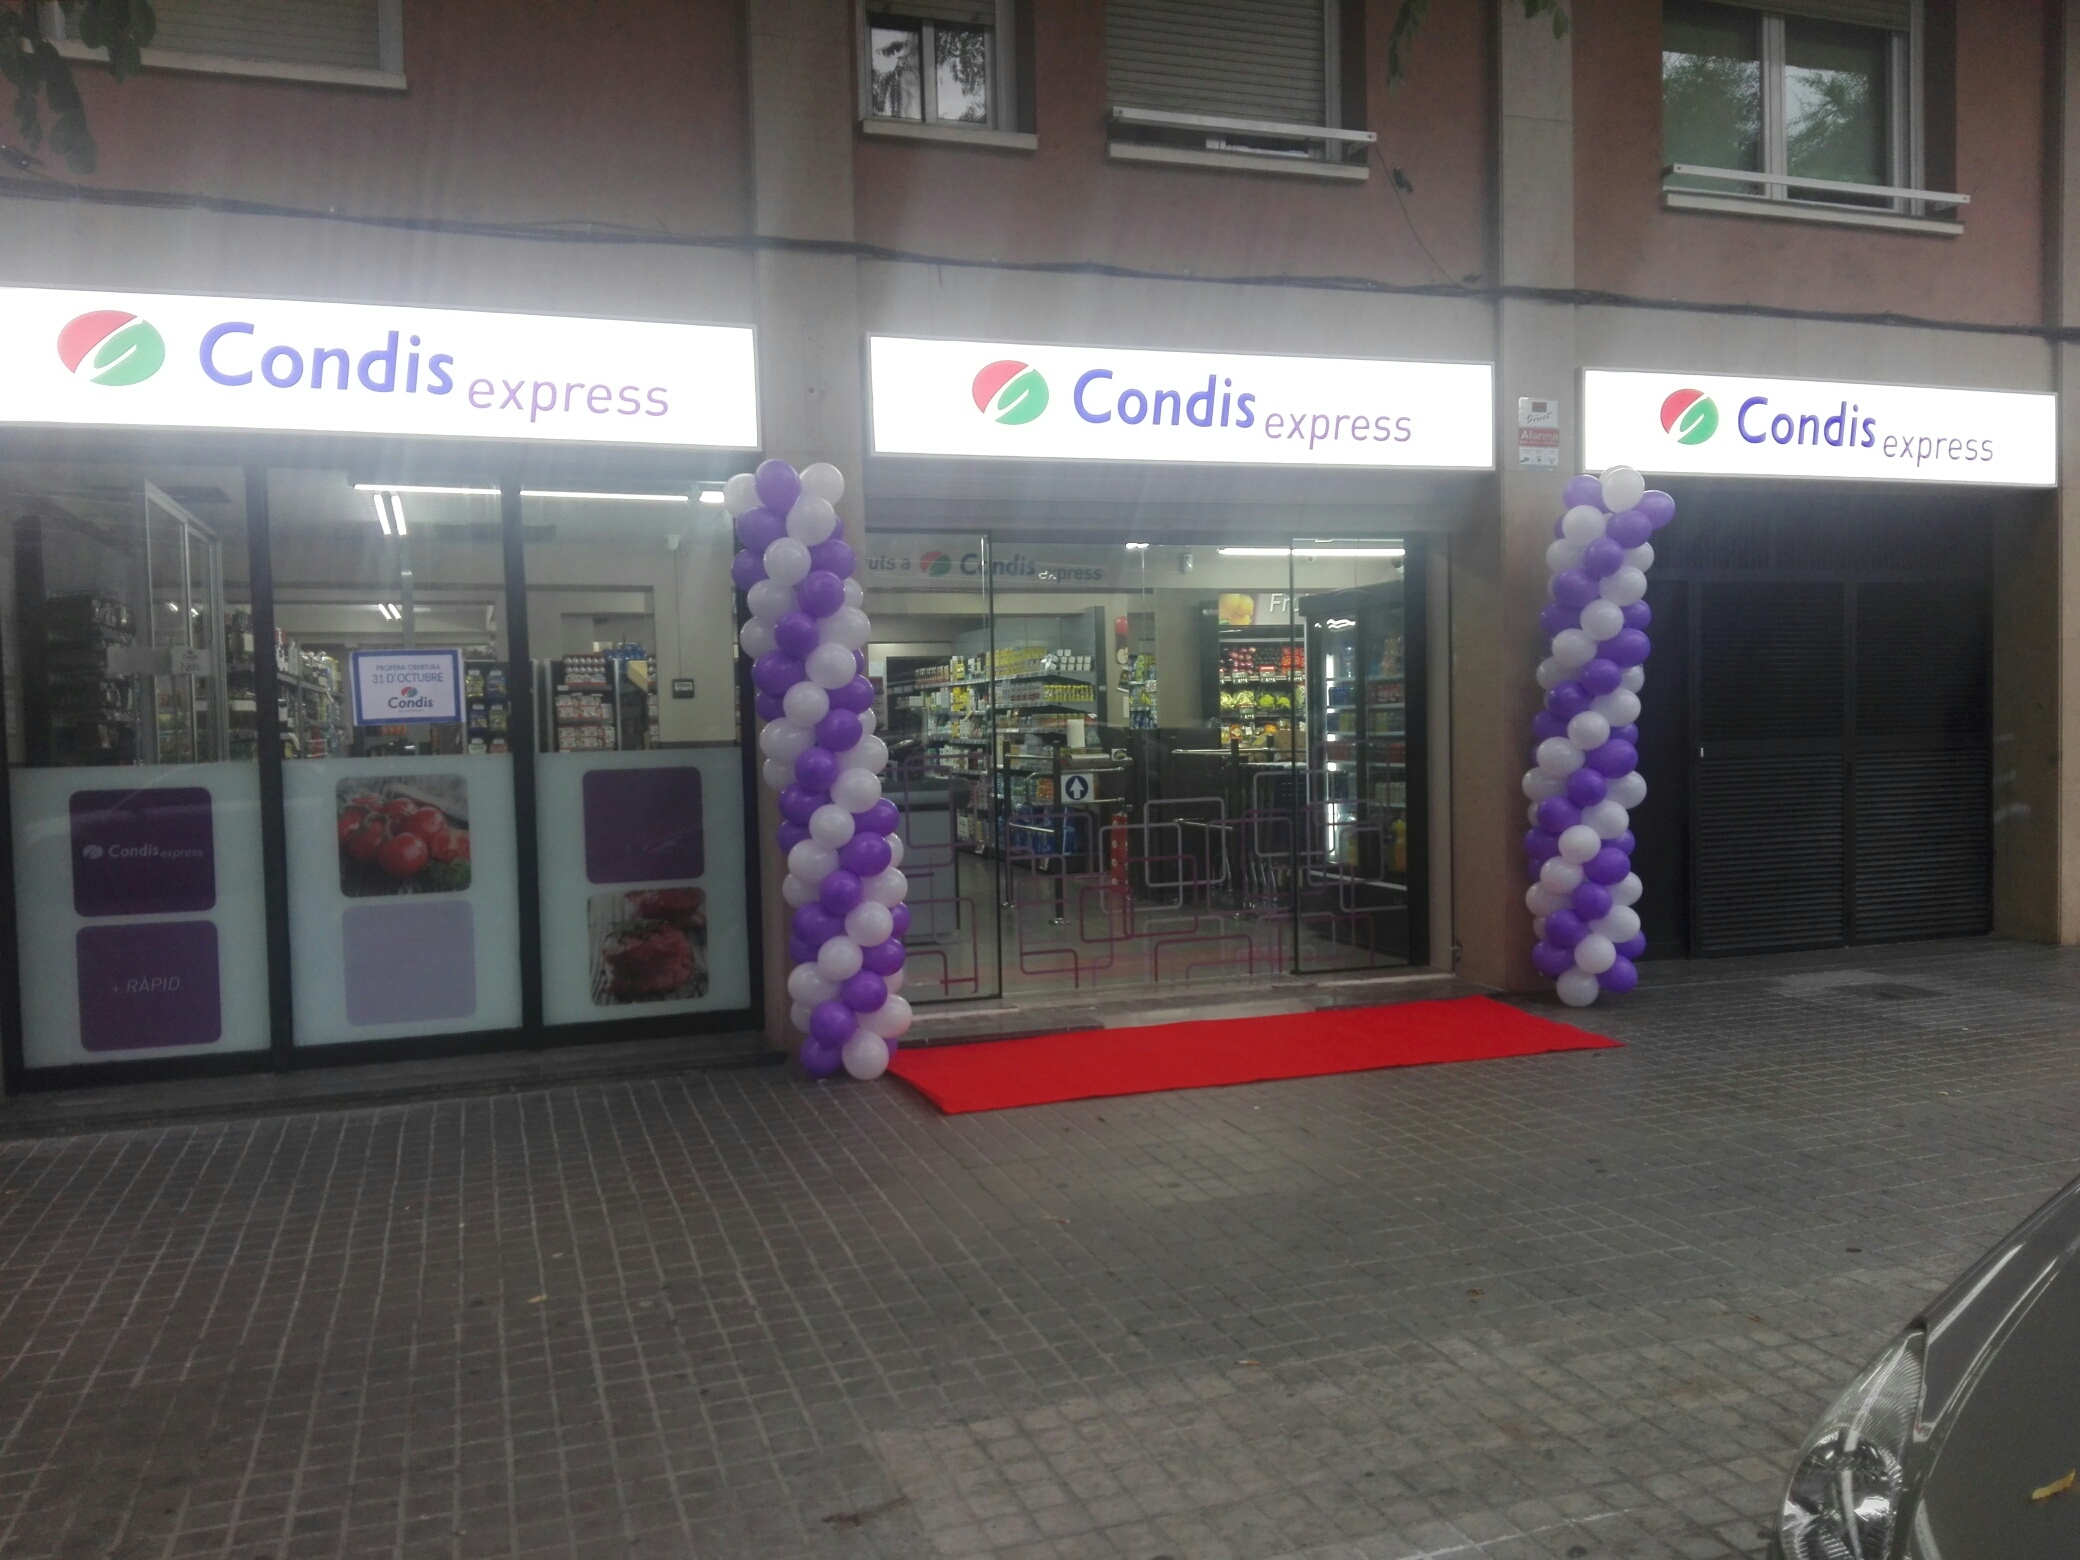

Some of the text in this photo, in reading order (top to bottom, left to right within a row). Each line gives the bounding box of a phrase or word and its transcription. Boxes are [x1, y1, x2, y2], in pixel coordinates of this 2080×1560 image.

[199, 321, 670, 423] Condis express
[1073, 368, 1412, 450] Condis express
[1737, 395, 1994, 468] Condis express
[372, 673, 384, 684] 31
[388, 696, 434, 709] Condis
[108, 843, 159, 858] Condis
